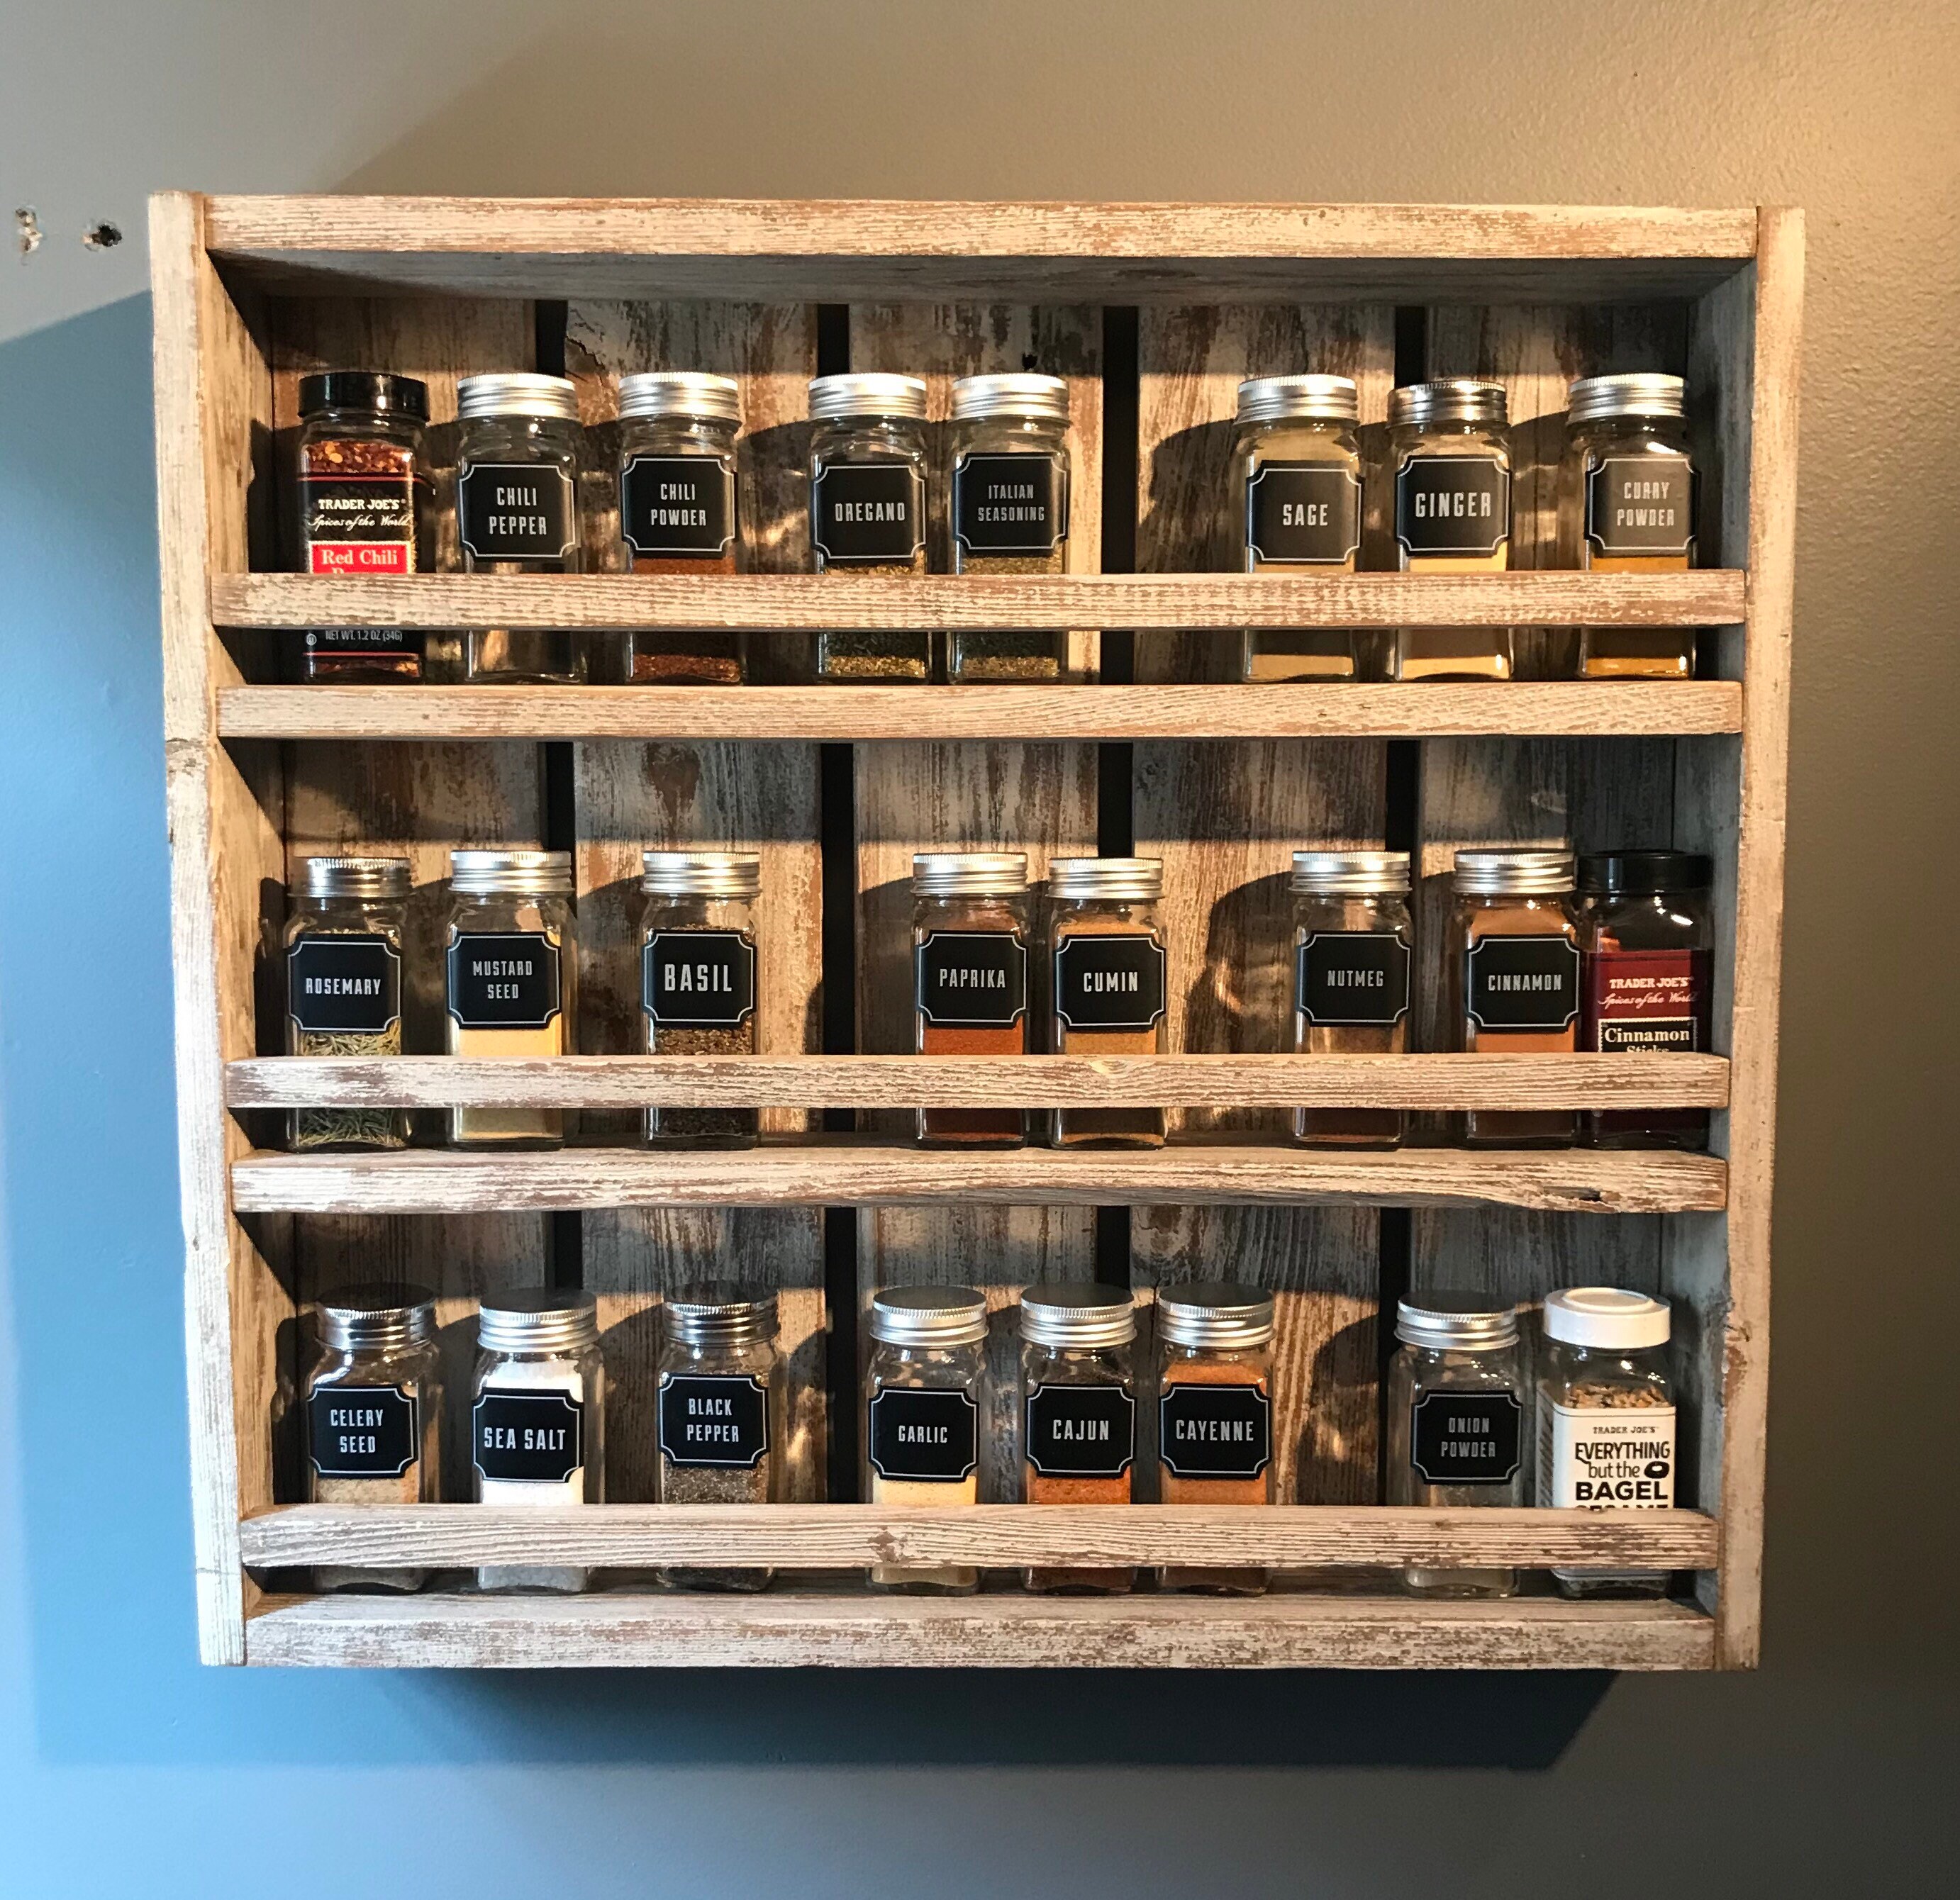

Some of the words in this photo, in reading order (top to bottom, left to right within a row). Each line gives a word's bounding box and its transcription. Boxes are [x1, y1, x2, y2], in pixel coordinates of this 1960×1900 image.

[496, 487, 537, 506] CHILI
[660, 484, 696, 501] CHILI
[988, 484, 1034, 500] ITALIAN
[1624, 481, 1671, 500] CURRY
[318, 499, 364, 510] TRADER
[835, 502, 906, 522] OREGANO
[1415, 491, 1491, 518] GINGER
[308, 514, 345, 532] Spices
[345, 515, 360, 532] of
[358, 515, 376, 527] the
[379, 514, 409, 527] World
[650, 508, 706, 526] POWDER
[978, 506, 1045, 522] SEASONING
[1283, 503, 1328, 526] SAGE
[1617, 508, 1675, 527] POWDER
[489, 515, 547, 535] PEPPER
[322, 549, 354, 565] Red
[360, 549, 398, 565] Chili
[325, 630, 340, 640] NET
[370, 630, 382, 640] OZ
[472, 961, 533, 976] MUSTARD
[664, 963, 733, 992] BASIL
[306, 978, 381, 995] ROSEMARY
[940, 968, 1006, 988] PAPRIKA
[1084, 971, 1138, 993] CUMIN
[1327, 970, 1383, 987] NUTMEG
[1488, 974, 1562, 991] CINNAMON
[1609, 978, 1655, 989] TRADER
[487, 983, 519, 999] SEED
[1598, 993, 1635, 1010] Spices
[1605, 1027, 1691, 1043] Cinnamon
[688, 1398, 733, 1416] BLACK
[330, 1409, 384, 1427] CELERY
[1448, 1417, 1490, 1434] ONION
[484, 1426, 516, 1450] SEA
[524, 1429, 566, 1451] SALT
[686, 1424, 739, 1443] PEPPER
[898, 1425, 948, 1443] GARLIC
[1052, 1419, 1109, 1441] CAJUN
[1176, 1419, 1254, 1441] CAYENNE
[1593, 1426, 1628, 1435] TRADER
[340, 1436, 376, 1453] SEED
[1440, 1441, 1496, 1458] POWDER
[1575, 1441, 1671, 1463] EVERYTHING
[1588, 1461, 1613, 1479] but
[1616, 1461, 1640, 1478] the
[1575, 1480, 1669, 1501] BAGEL
